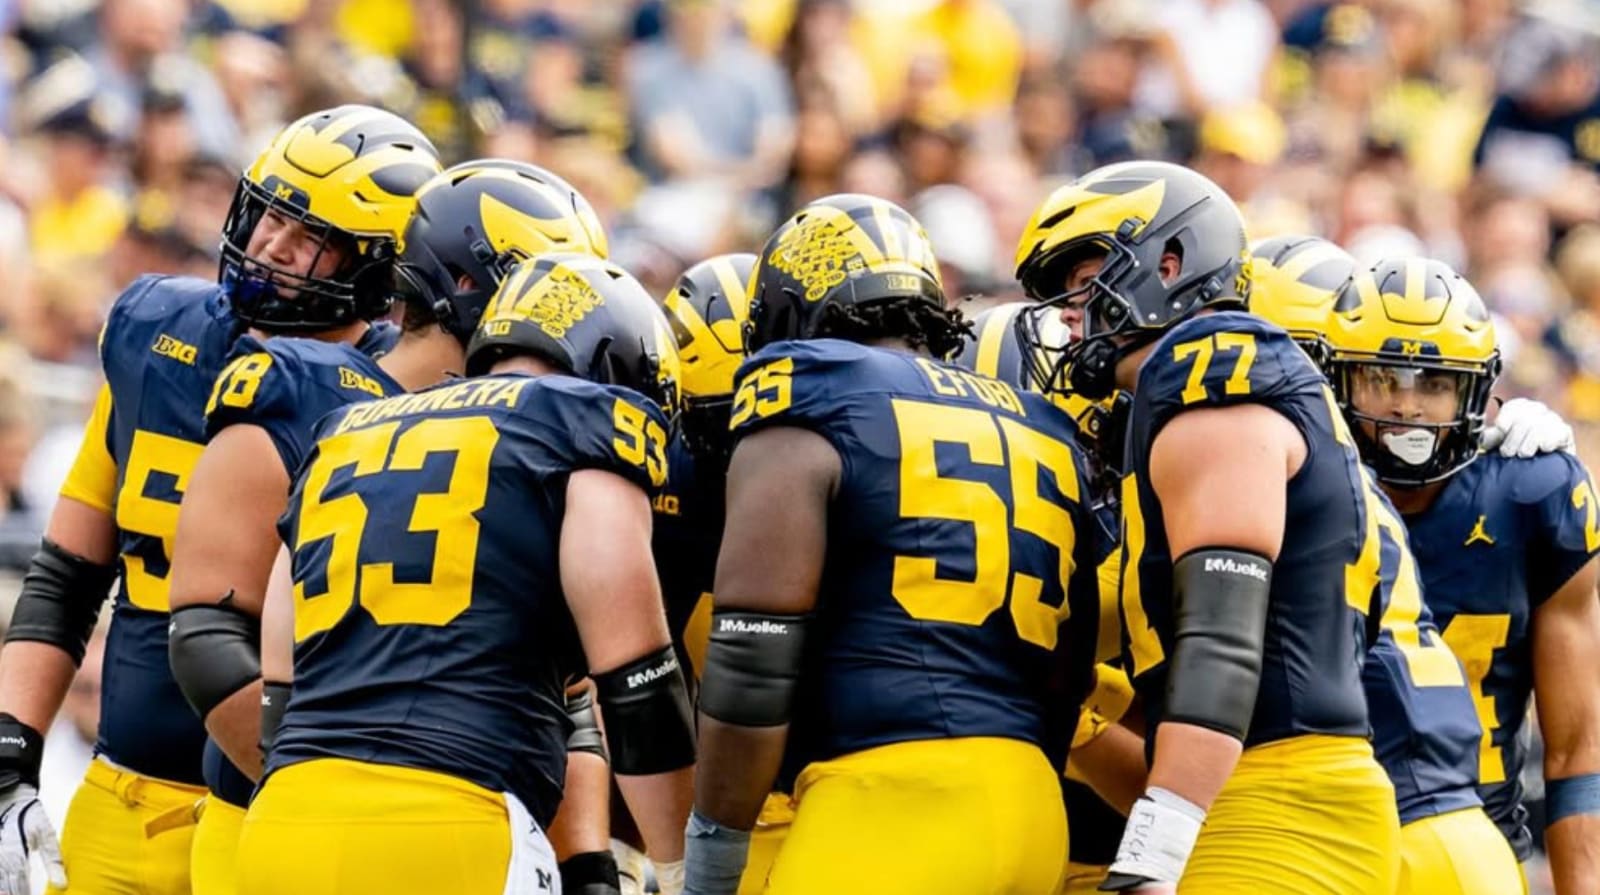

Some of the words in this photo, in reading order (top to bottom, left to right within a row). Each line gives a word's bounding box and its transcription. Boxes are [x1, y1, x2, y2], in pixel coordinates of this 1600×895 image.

[275, 183, 293, 200] M
[1174, 332, 1258, 405] 77
[1402, 341, 1421, 356] M
[728, 356, 794, 431] 55
[293, 416, 500, 645] 53
[891, 399, 1080, 651] 55
